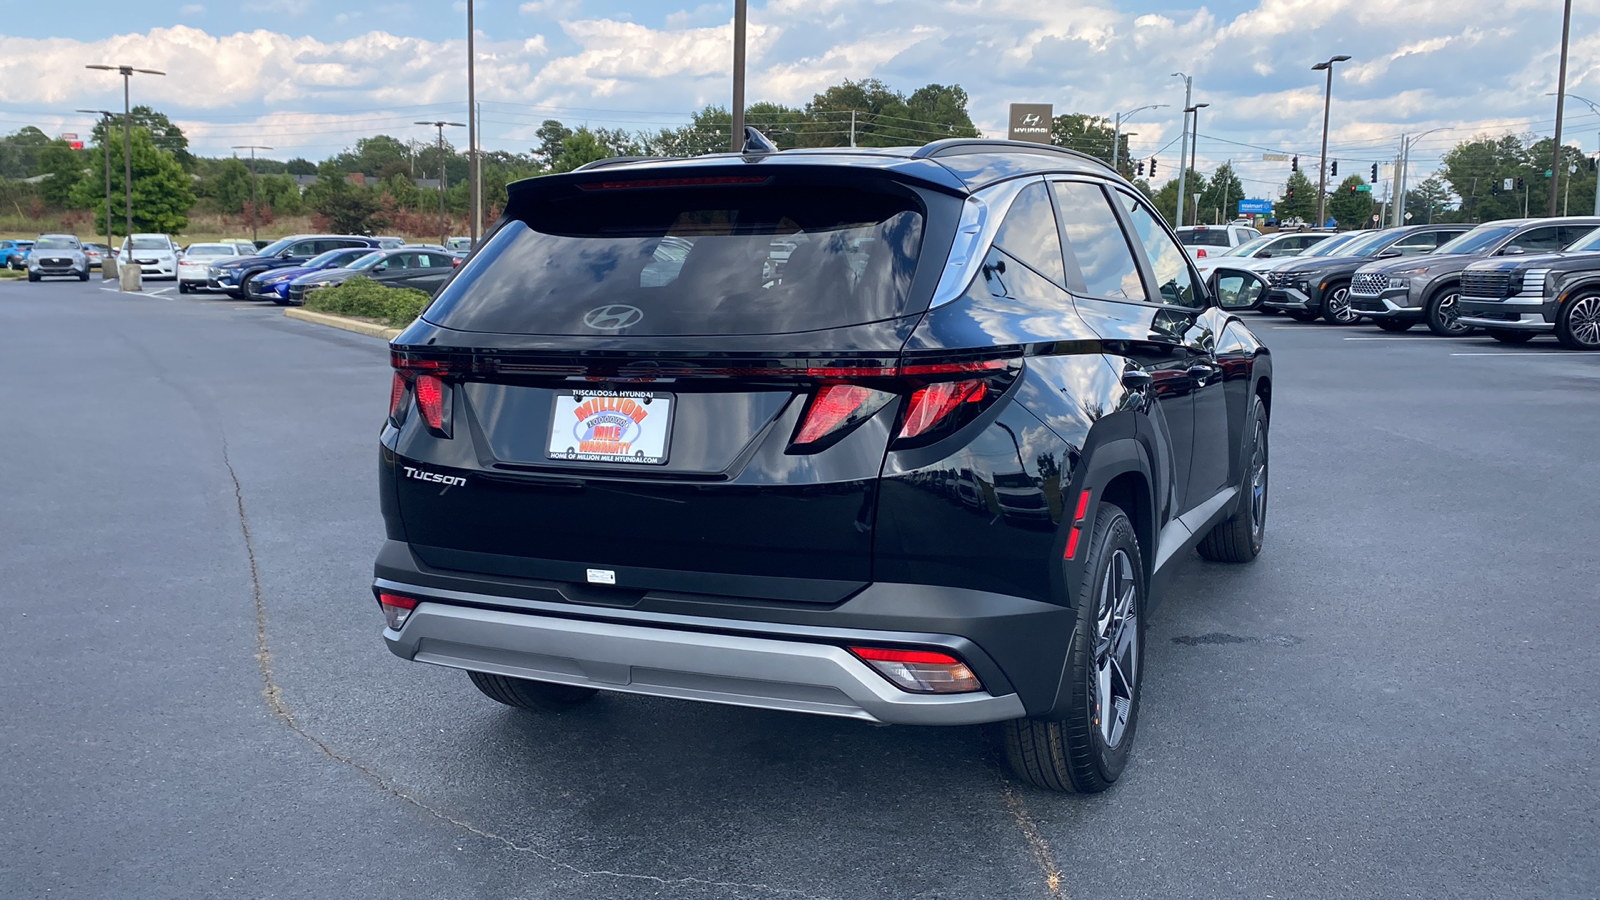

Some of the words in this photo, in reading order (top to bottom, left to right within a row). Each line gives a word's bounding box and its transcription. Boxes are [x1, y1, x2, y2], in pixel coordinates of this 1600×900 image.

[572, 389, 618, 397] TUSCALOOSA
[573, 397, 648, 425] MILLION
[593, 426, 621, 441] MILE
[579, 441, 632, 454] WARRANTY
